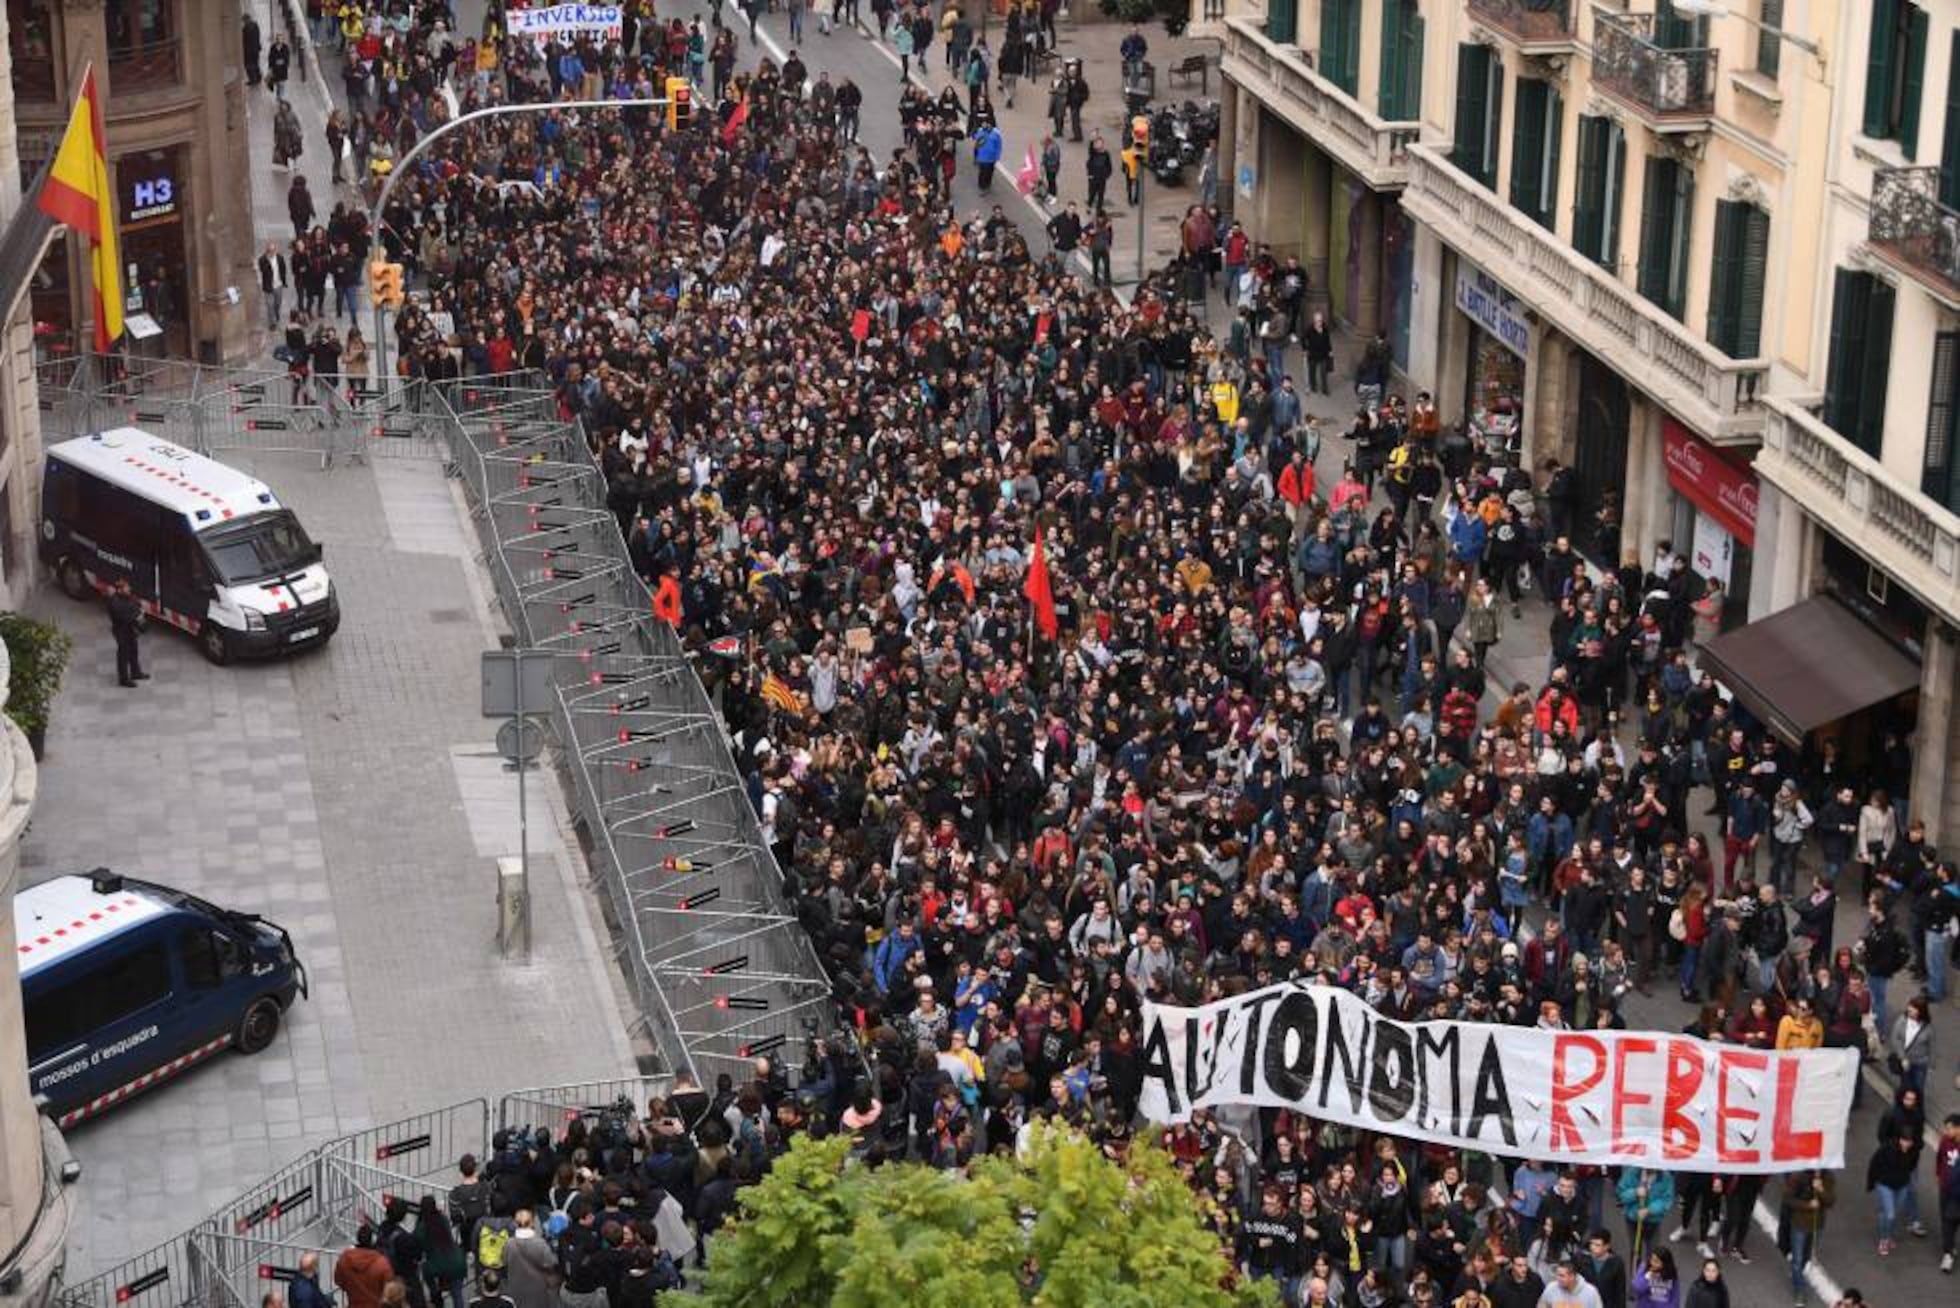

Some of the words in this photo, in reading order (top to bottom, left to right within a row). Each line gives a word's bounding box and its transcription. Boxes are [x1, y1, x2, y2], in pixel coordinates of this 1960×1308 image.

[135, 178, 172, 207] H3
[39, 1057, 89, 1089] mossos
[1550, 1034, 1823, 1163] REBEL
